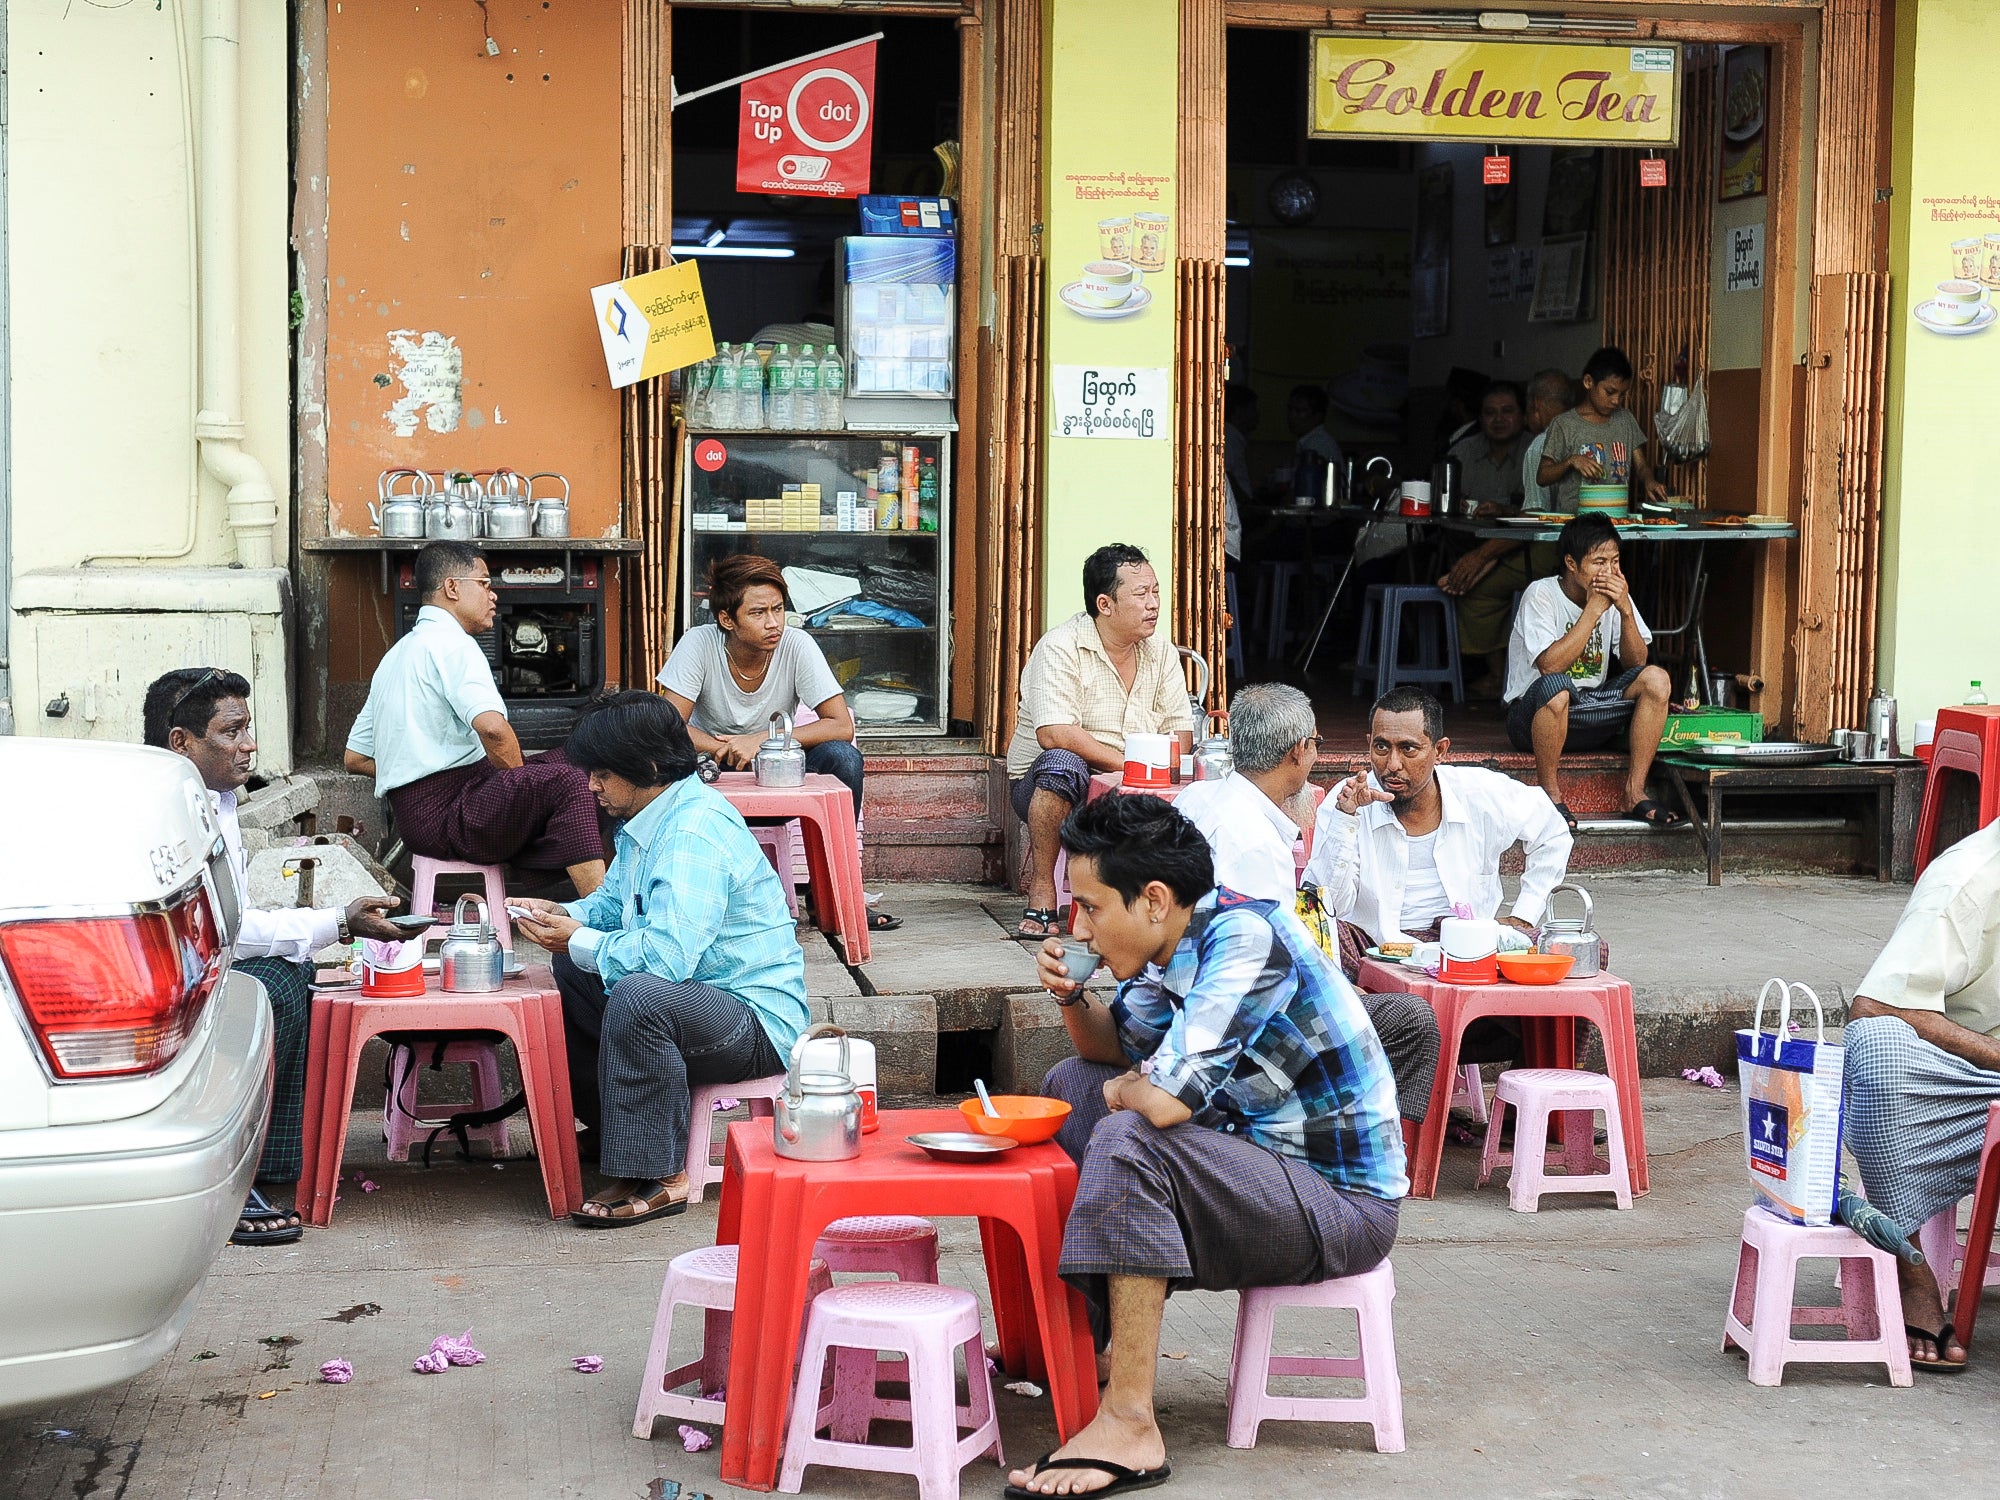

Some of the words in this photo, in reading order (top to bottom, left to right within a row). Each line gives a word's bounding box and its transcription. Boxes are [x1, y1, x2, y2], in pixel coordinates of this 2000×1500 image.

[1329, 58, 1547, 120] Golden
[1556, 70, 1661, 123] Tea
[747, 100, 783, 122] Top
[819, 99, 852, 122] dot
[754, 121, 783, 144] Up
[799, 160, 821, 175] Pay
[1100, 227, 1112, 235] MY
[1114, 225, 1129, 235] BOY
[1134, 220, 1146, 230] MY
[1148, 223, 1167, 231] BOY
[1965, 246, 1980, 255] BOY
[1984, 240, 1995, 250] MY
[1085, 283, 1095, 291] MY
[798, 368, 816, 378] Life
[705, 449, 723, 462] dot
[1660, 719, 1701, 746] Lemon
